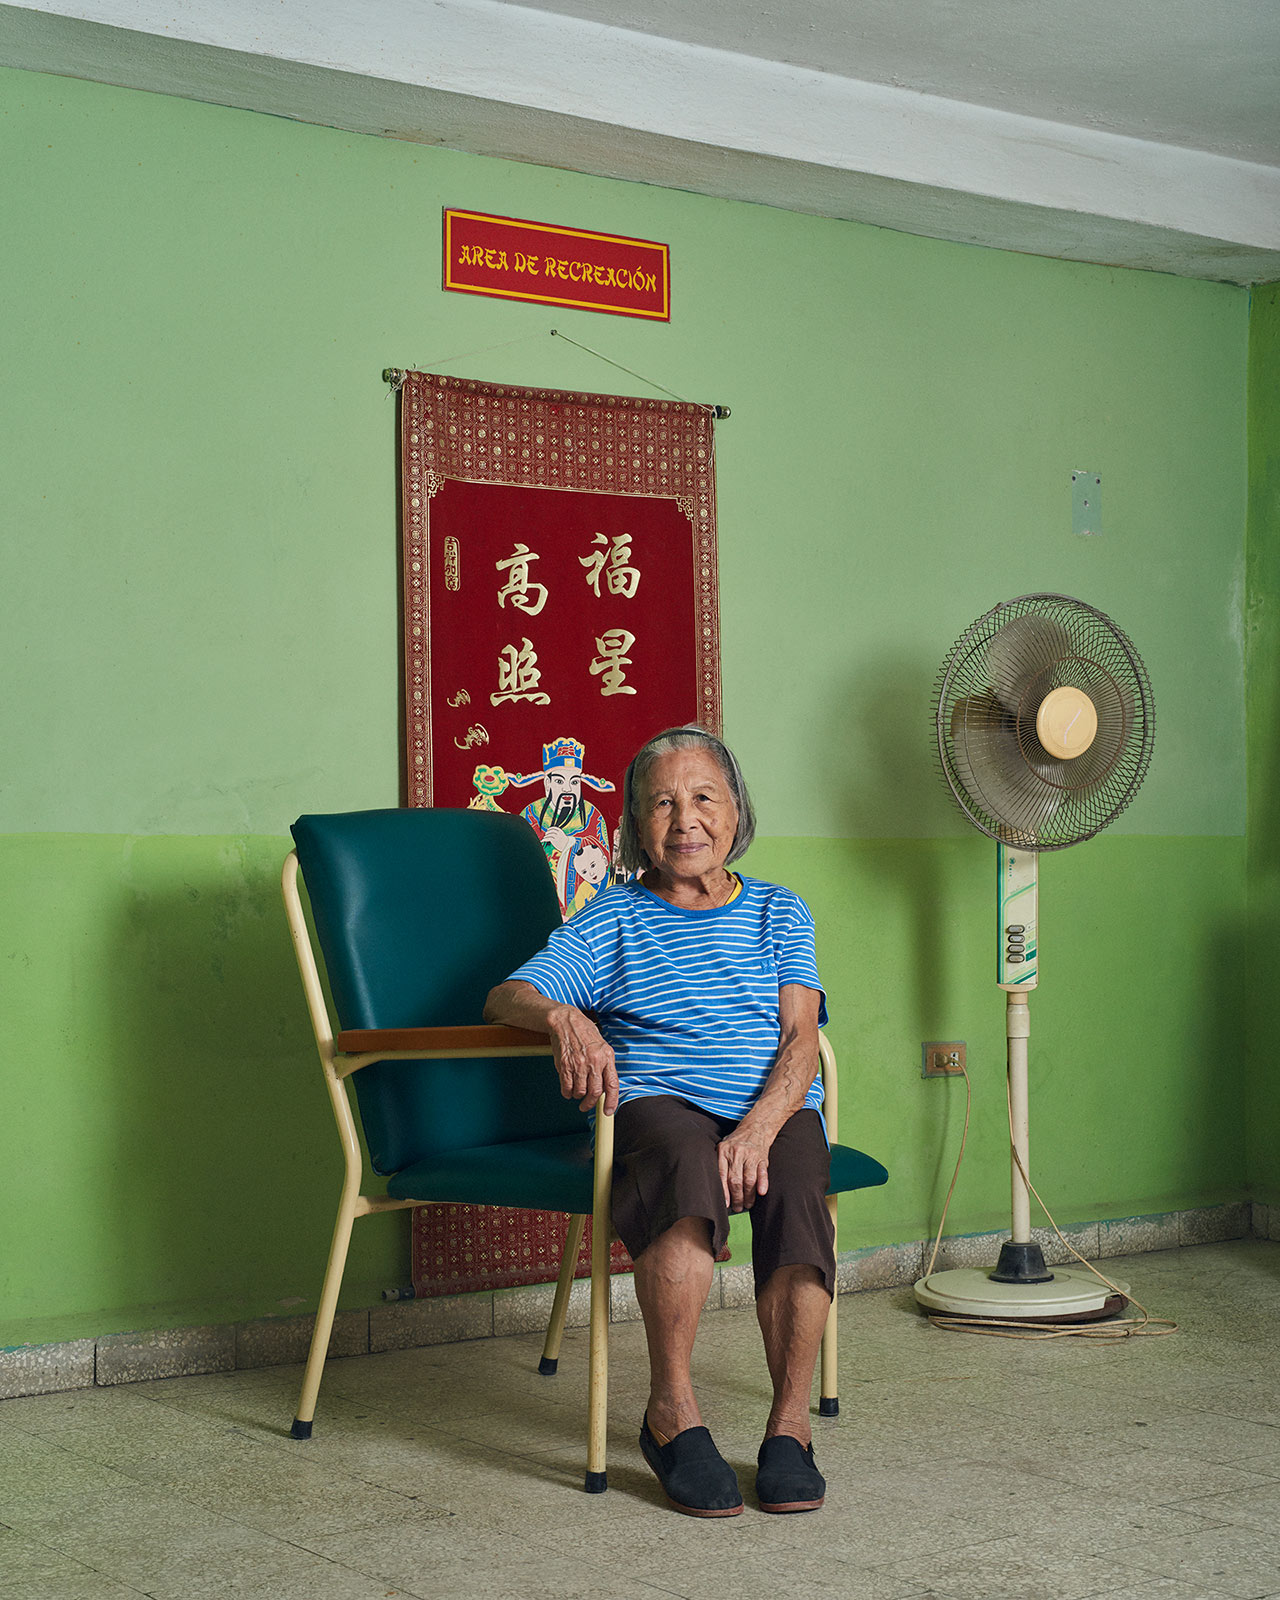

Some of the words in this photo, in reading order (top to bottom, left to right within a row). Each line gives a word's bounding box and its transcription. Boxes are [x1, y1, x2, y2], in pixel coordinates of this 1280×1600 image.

[458, 244, 510, 272] AREA
[513, 251, 540, 276] DE
[543, 256, 657, 293] RECREACIÓN
[489, 542, 552, 708] 高照
[577, 532, 642, 697] 福星
